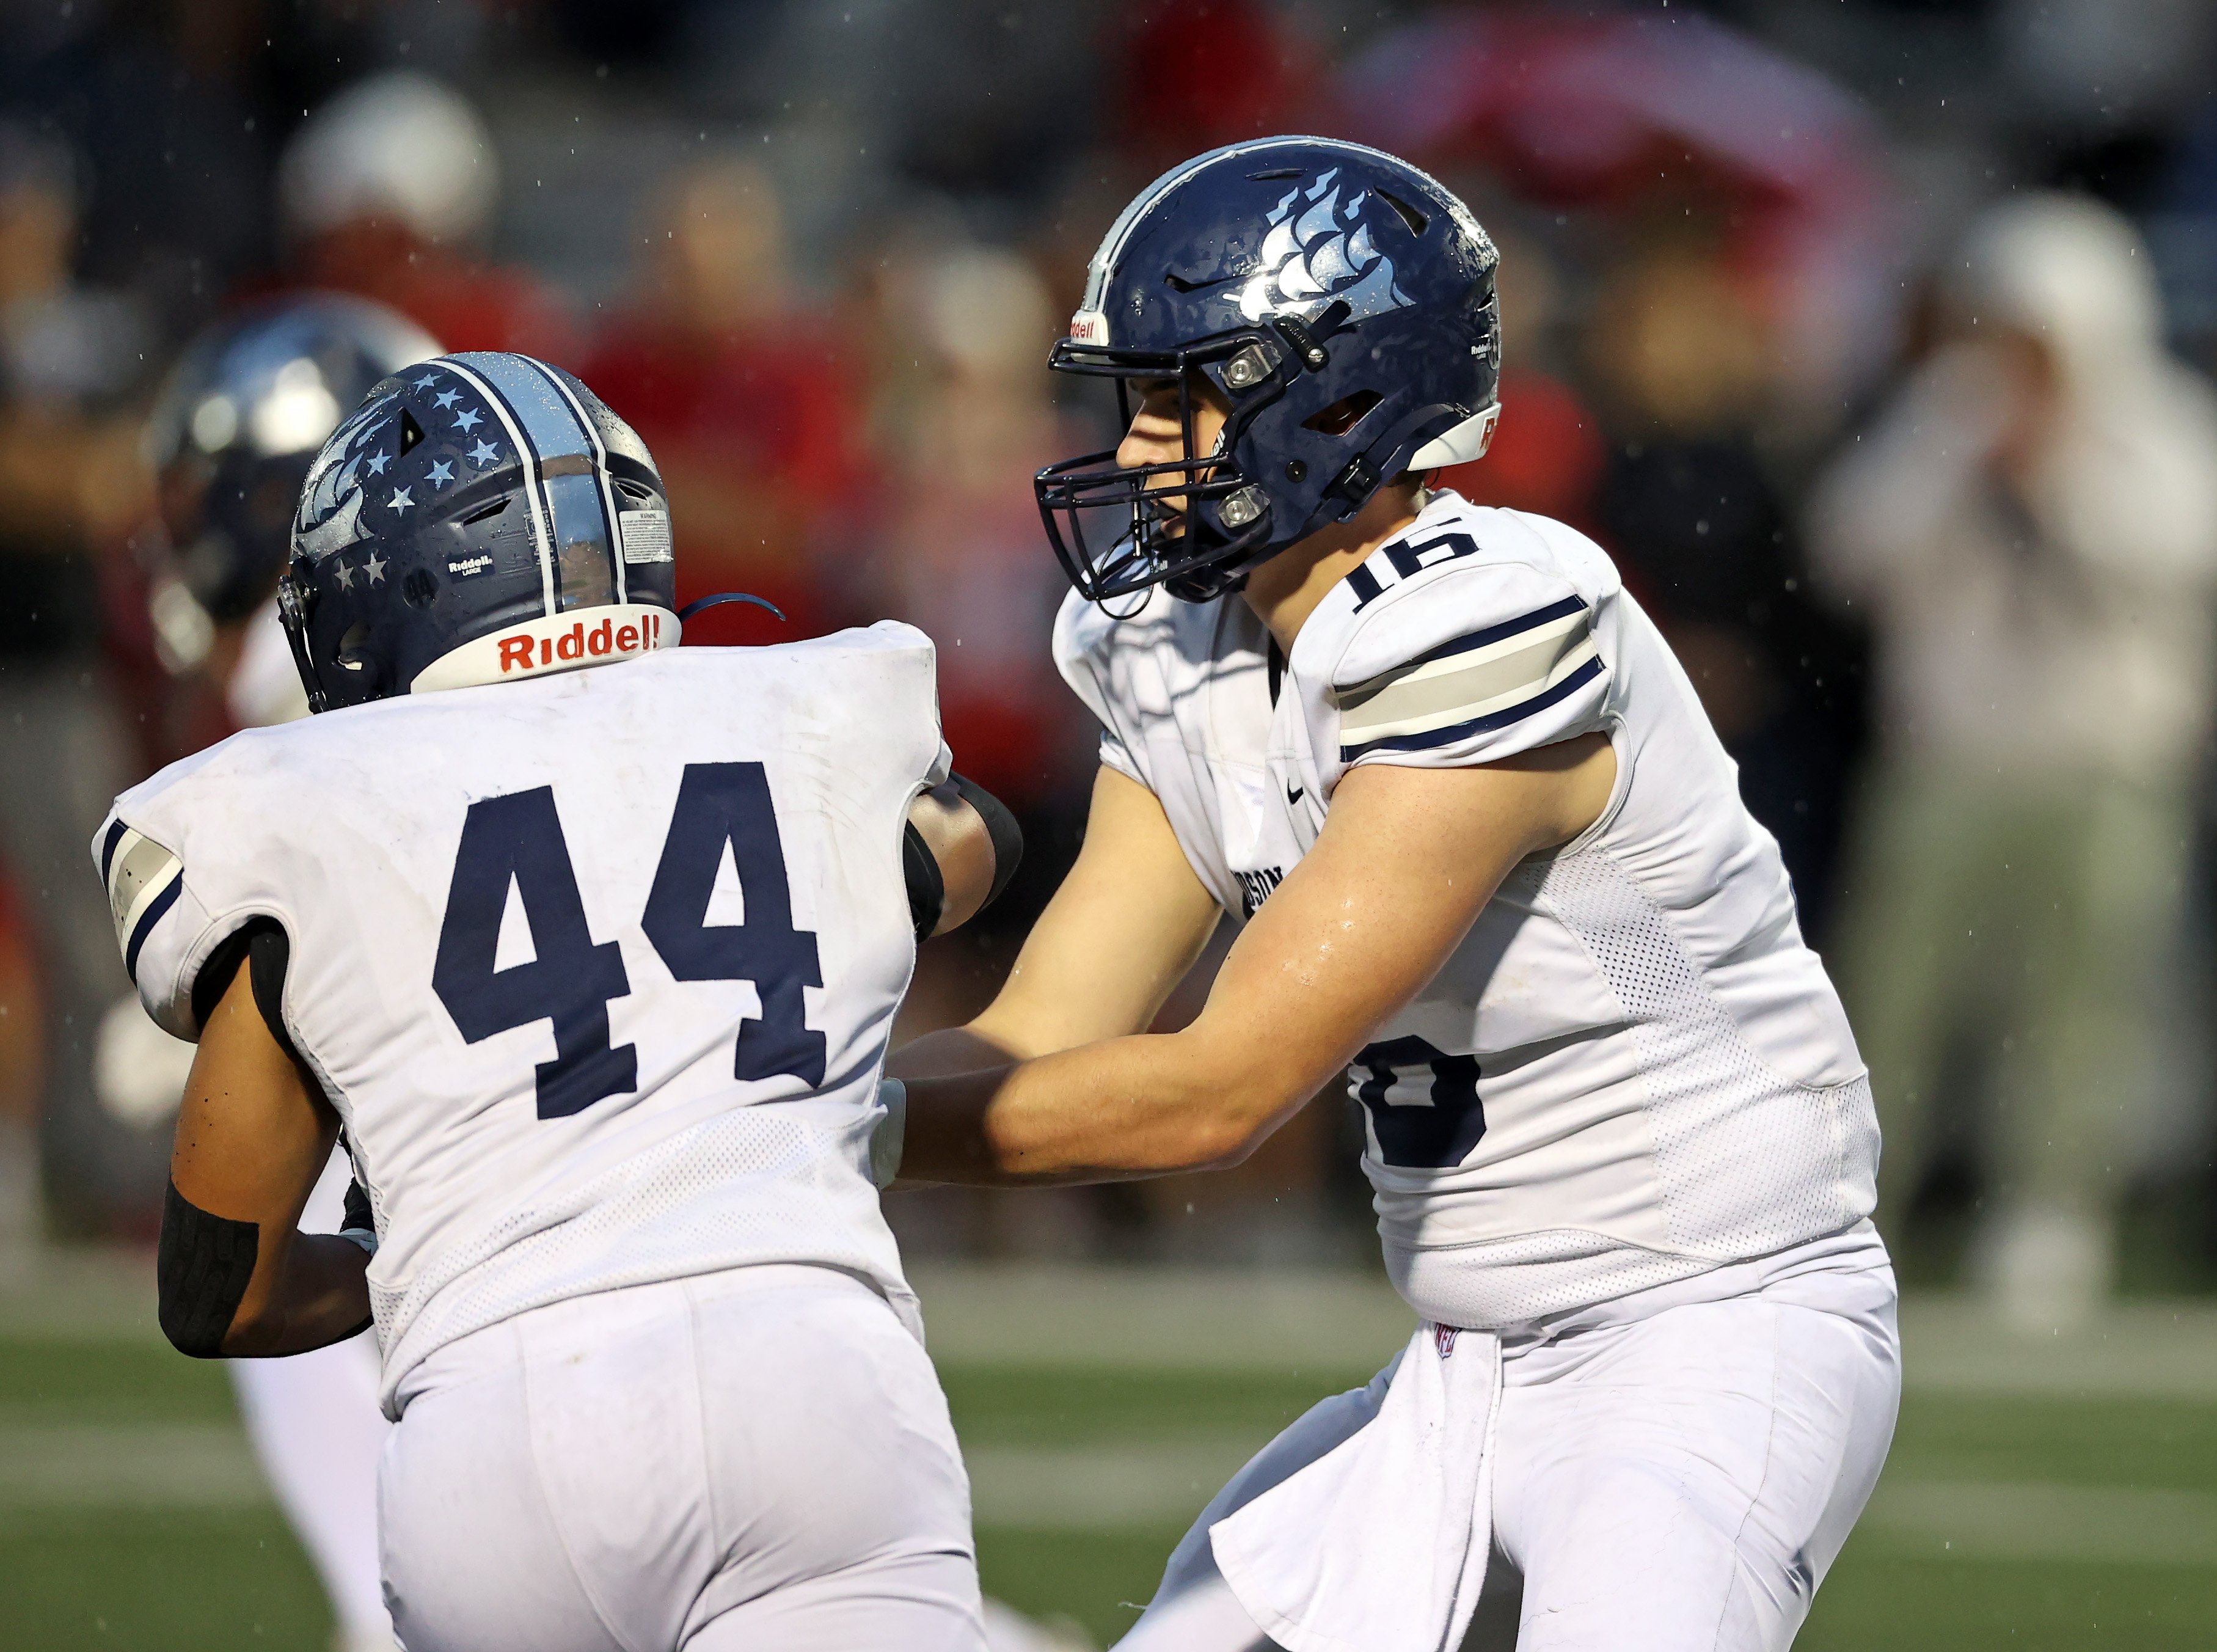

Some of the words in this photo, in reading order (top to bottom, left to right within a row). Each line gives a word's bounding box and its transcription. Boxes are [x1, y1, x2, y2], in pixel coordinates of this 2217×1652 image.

[448, 555, 490, 572] Riddell
[462, 567, 481, 576] LARGE
[1346, 517, 1479, 615] 16
[498, 615, 659, 673] Riddell
[431, 761, 826, 1120] 44
